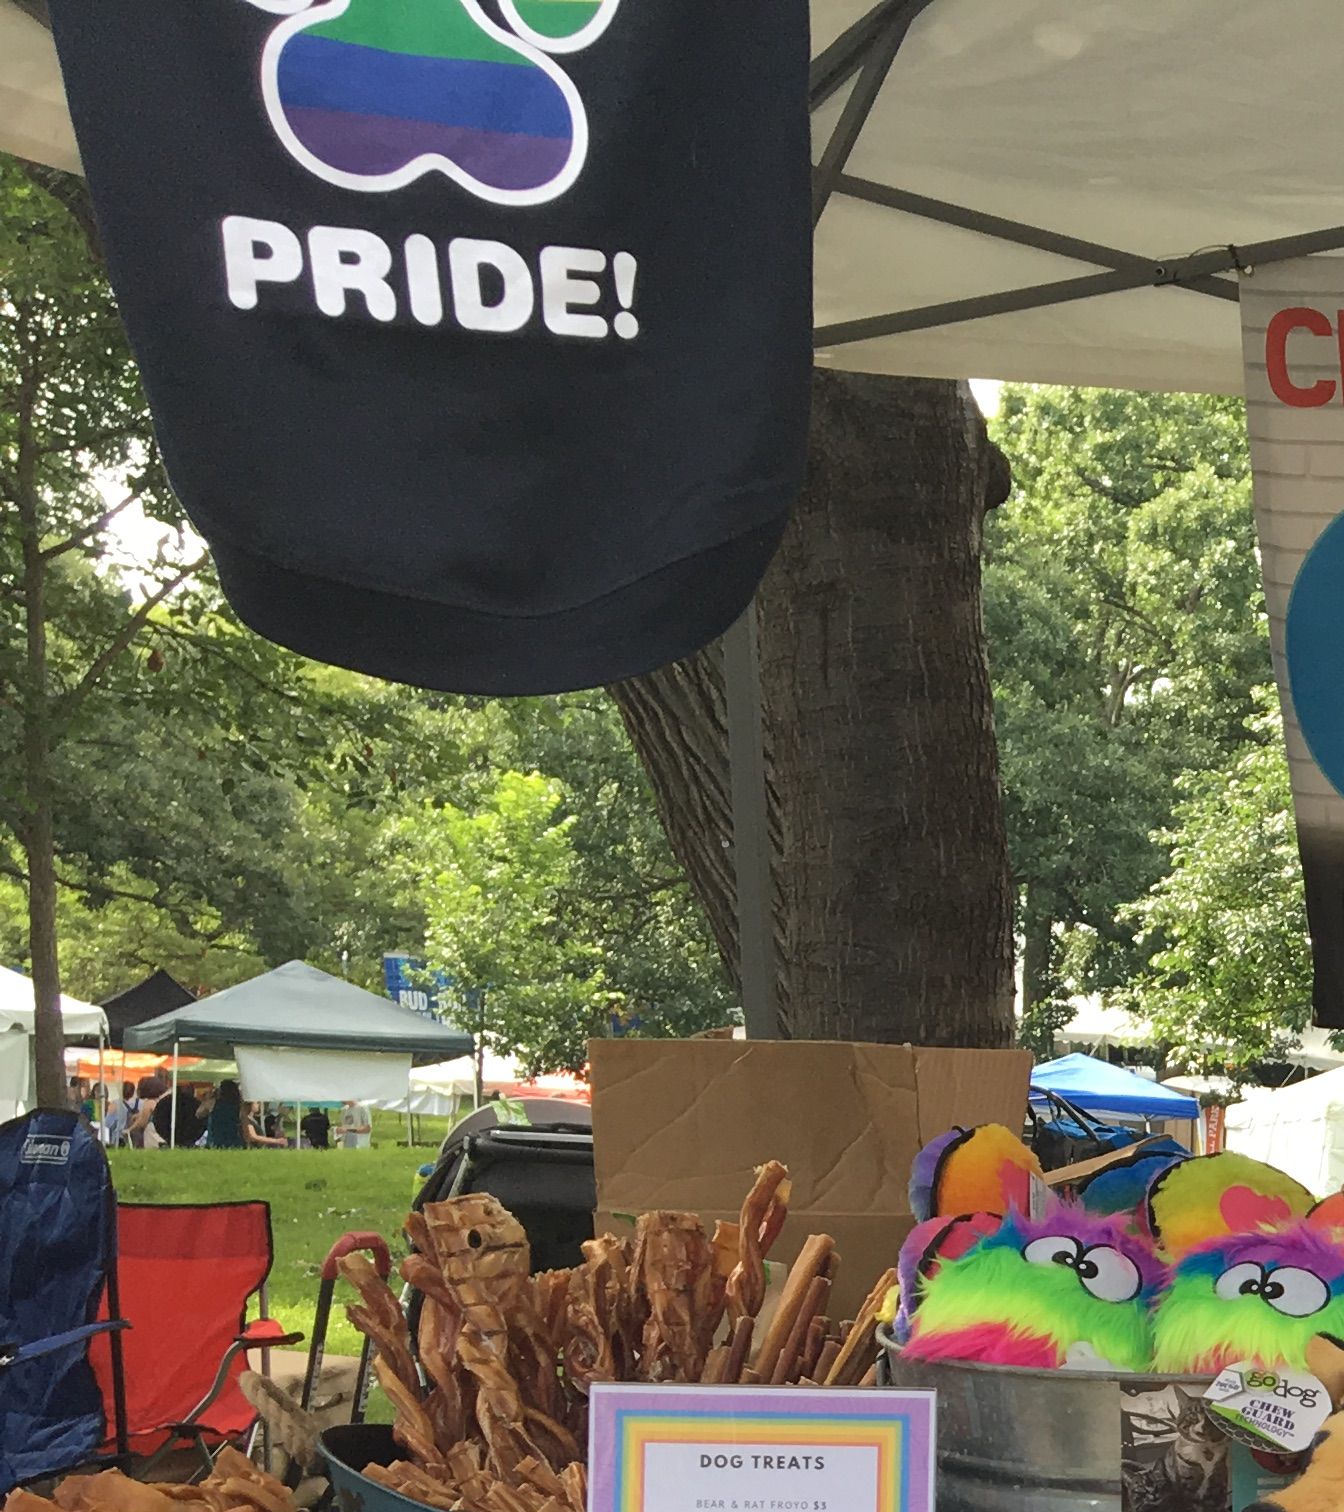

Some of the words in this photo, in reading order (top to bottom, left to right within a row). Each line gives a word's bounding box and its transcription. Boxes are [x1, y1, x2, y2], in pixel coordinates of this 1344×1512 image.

[221, 215, 640, 340] PRIDE!
[1241, 1406, 1295, 1431] GUARD
[1249, 1399, 1297, 1419] CHEW
[699, 1454, 744, 1469] DOG
[751, 1455, 825, 1471] TREATS
[696, 1499, 725, 1510] BEAR
[730, 1500, 739, 1510] &
[744, 1500, 766, 1510] RAT
[770, 1500, 810, 1511] FROYO
